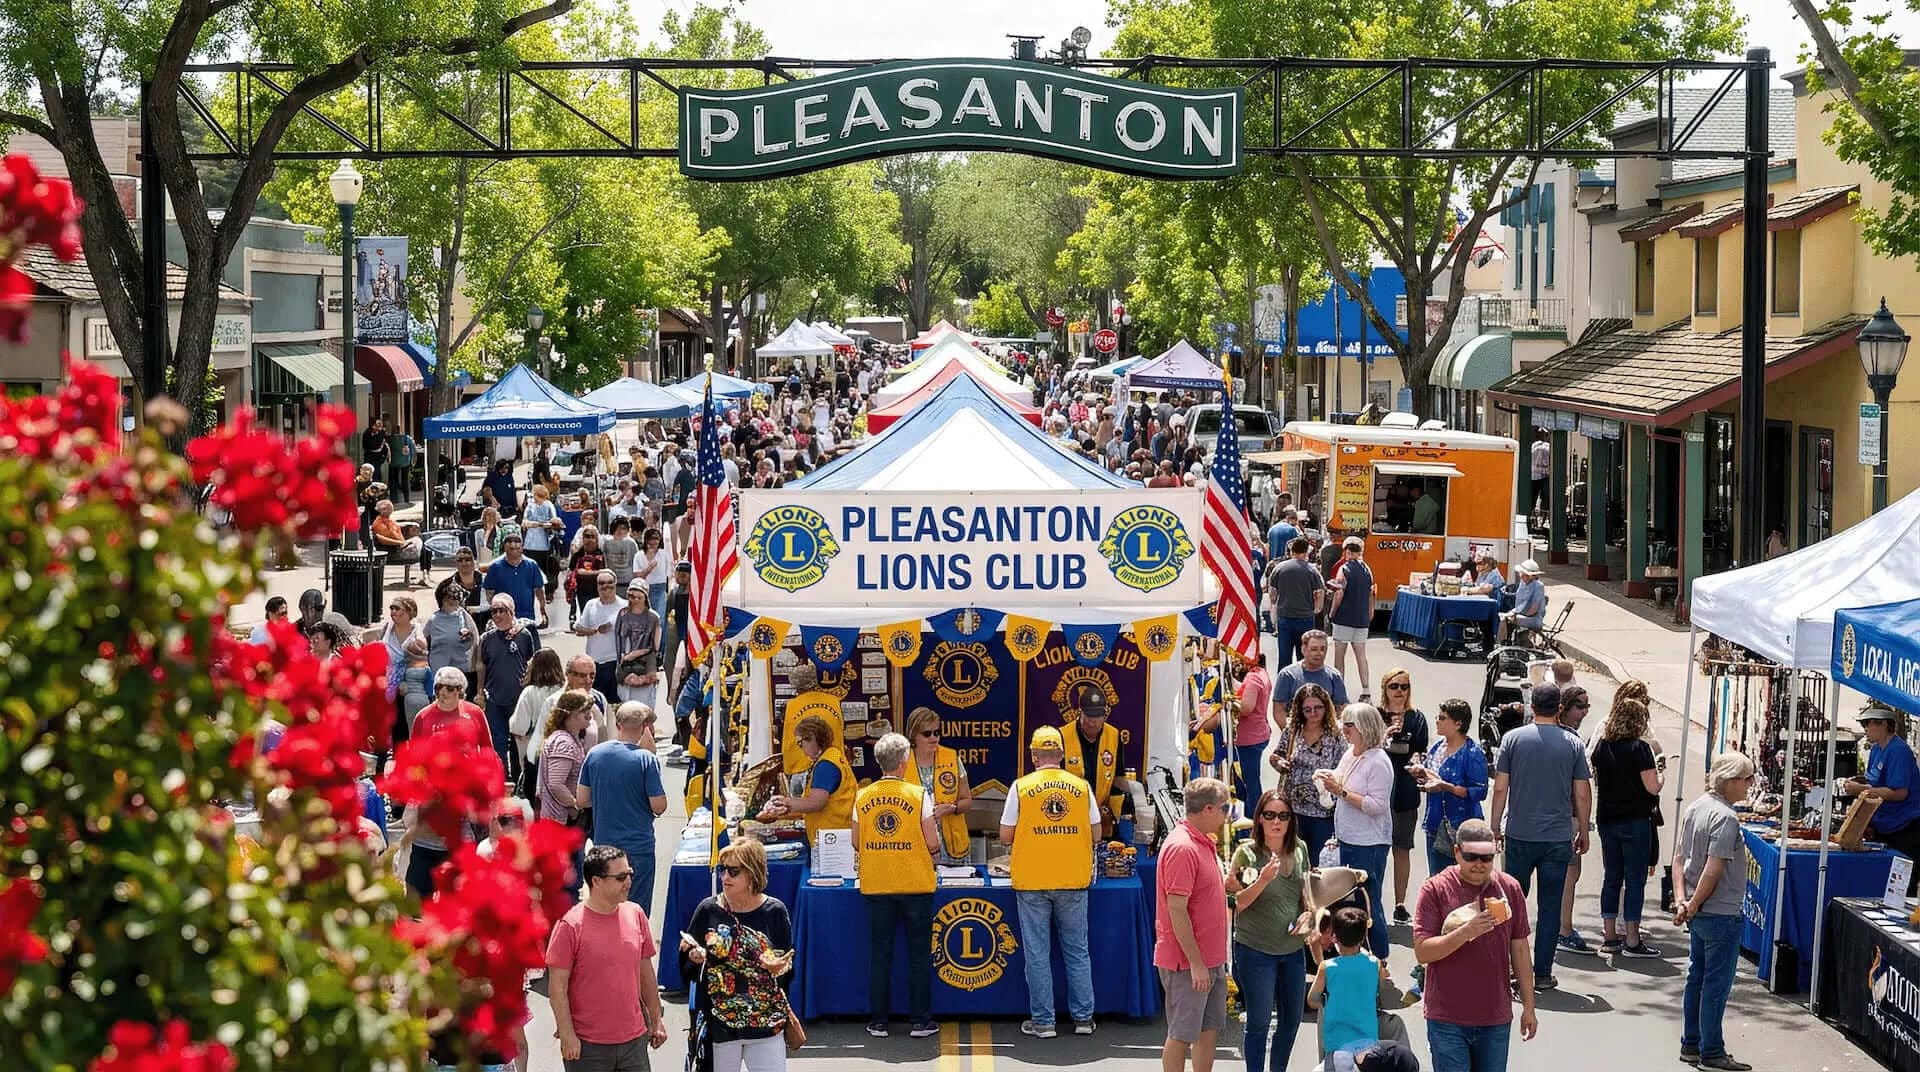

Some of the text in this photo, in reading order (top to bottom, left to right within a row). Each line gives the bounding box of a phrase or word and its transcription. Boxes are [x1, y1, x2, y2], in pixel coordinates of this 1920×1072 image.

[700, 77, 1222, 157] PLEASANTON
[763, 508, 821, 528] LIONS
[842, 506, 1100, 542] PLEASANTON
[1118, 508, 1176, 528] LIONS
[781, 532, 806, 562] L
[1136, 532, 1161, 562] L
[857, 553, 1087, 590] LIONS CLUB
[1034, 645, 1140, 670] LION LUB
[941, 721, 1012, 737] UNTEERS
[960, 927, 984, 959] L
